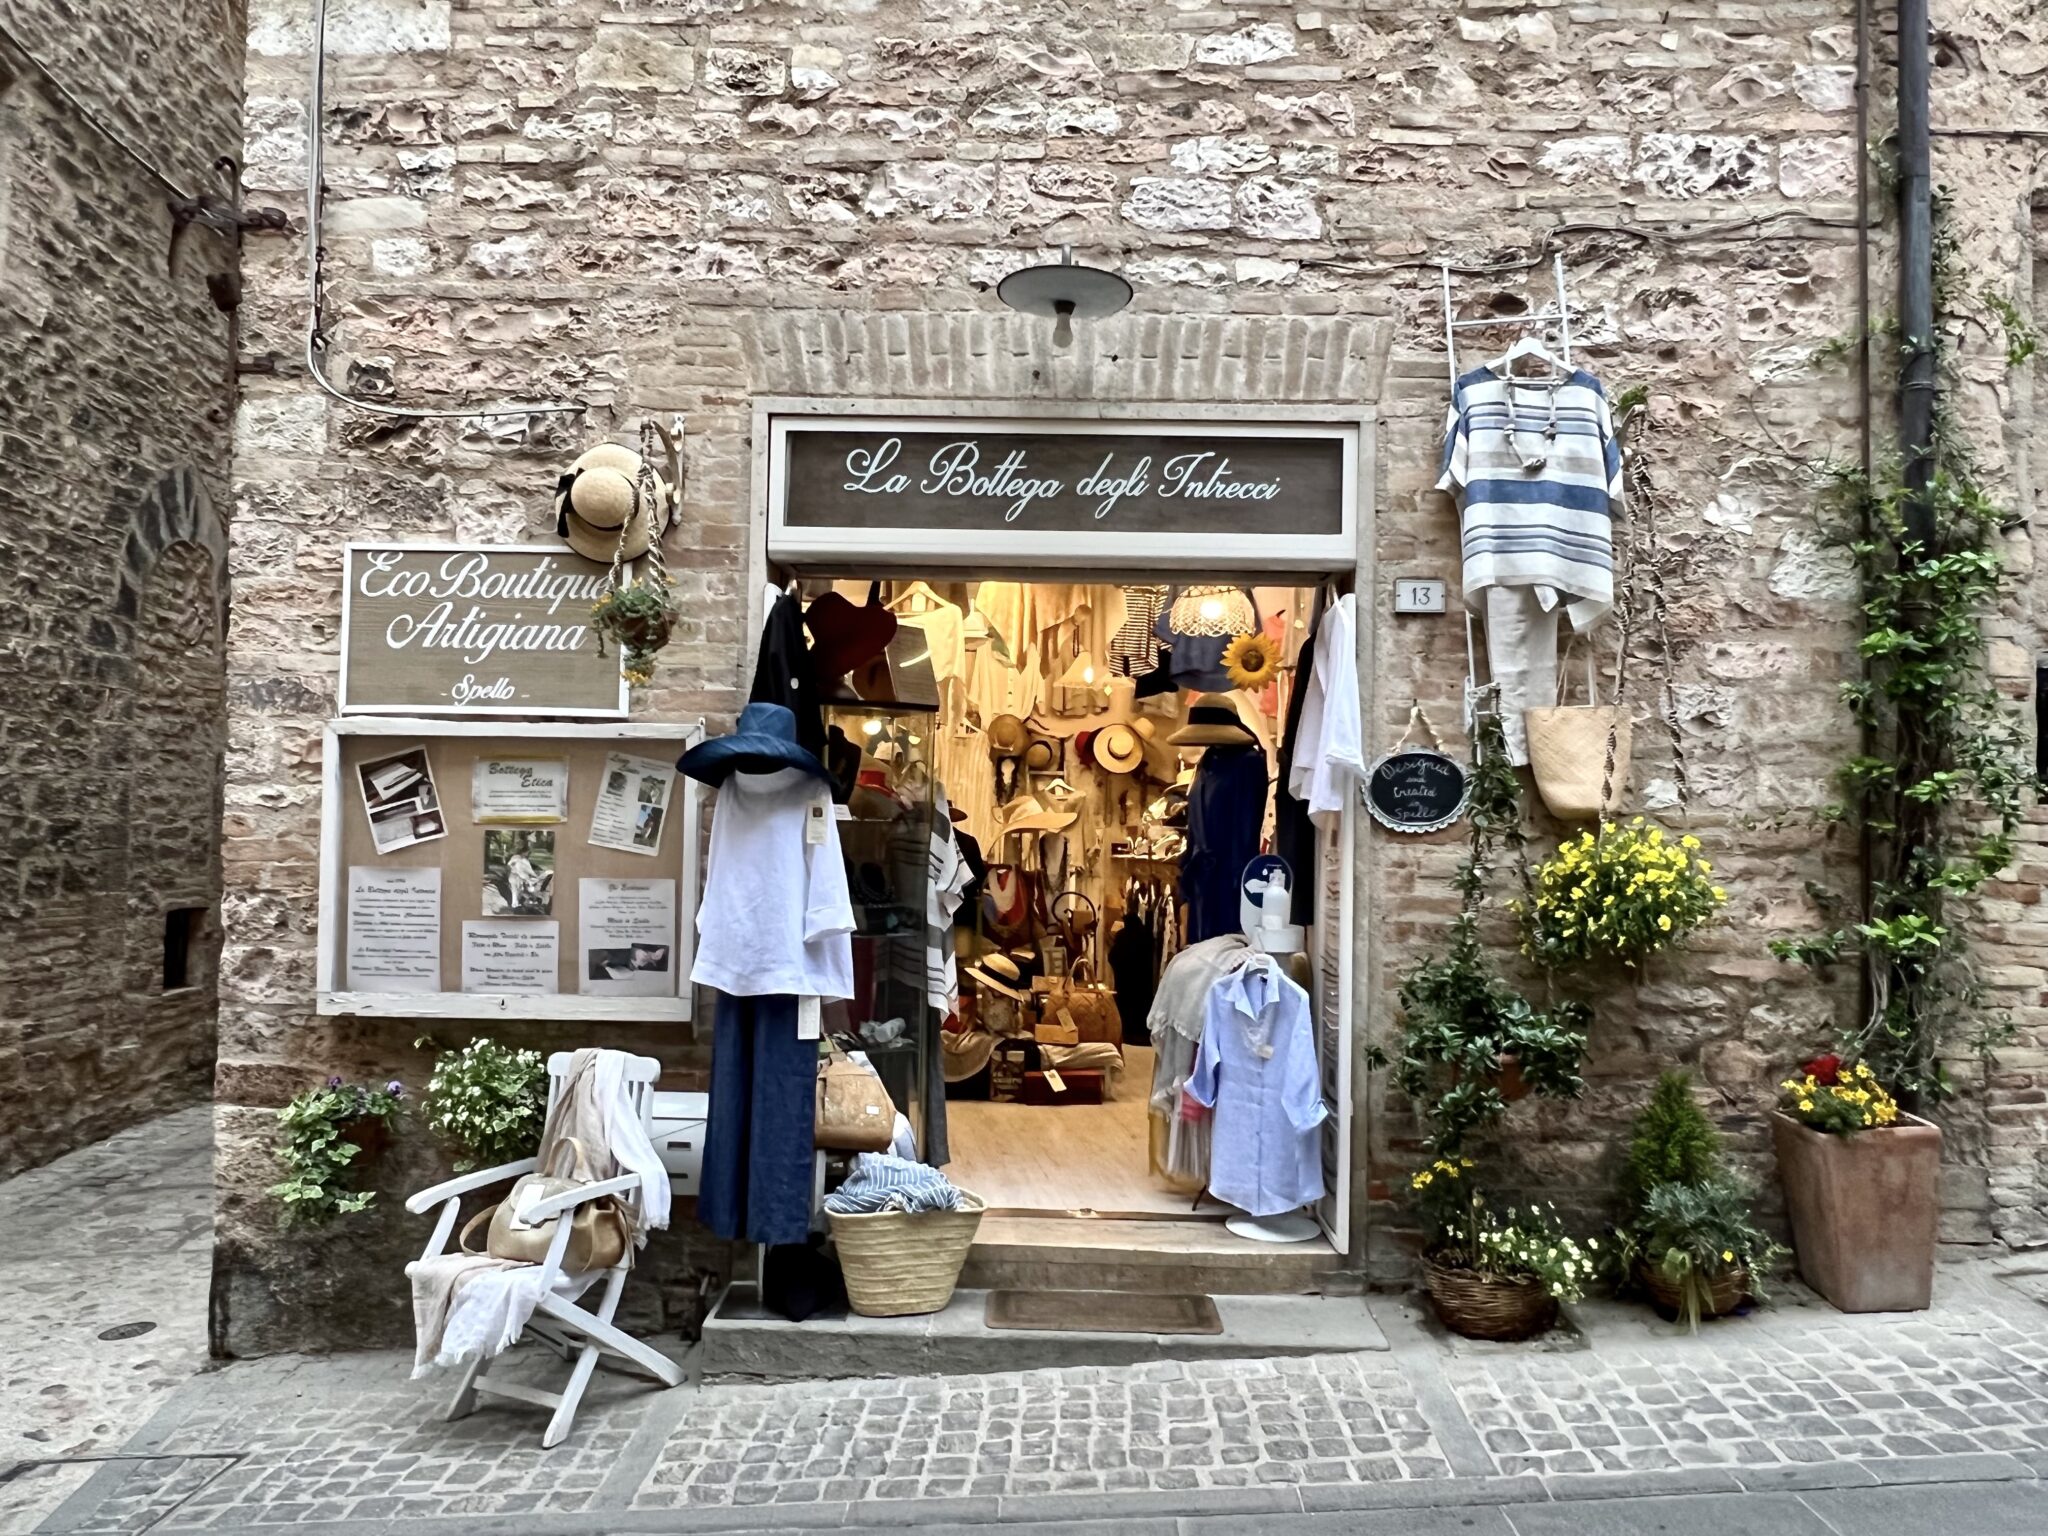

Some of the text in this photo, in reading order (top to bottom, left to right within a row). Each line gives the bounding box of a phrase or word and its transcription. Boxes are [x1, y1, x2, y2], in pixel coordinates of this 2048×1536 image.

[843, 437, 1282, 522] La Bottega degli Intrecci
[359, 551, 611, 616] Eco Boutique
[1412, 586, 1431, 606] 13
[385, 601, 588, 665] Artigiana
[450, 673, 517, 707] Spello
[488, 761, 533, 778] Bottega
[1380, 758, 1450, 780] Designed
[521, 774, 554, 788] Etica
[1394, 806, 1439, 821] Spello
